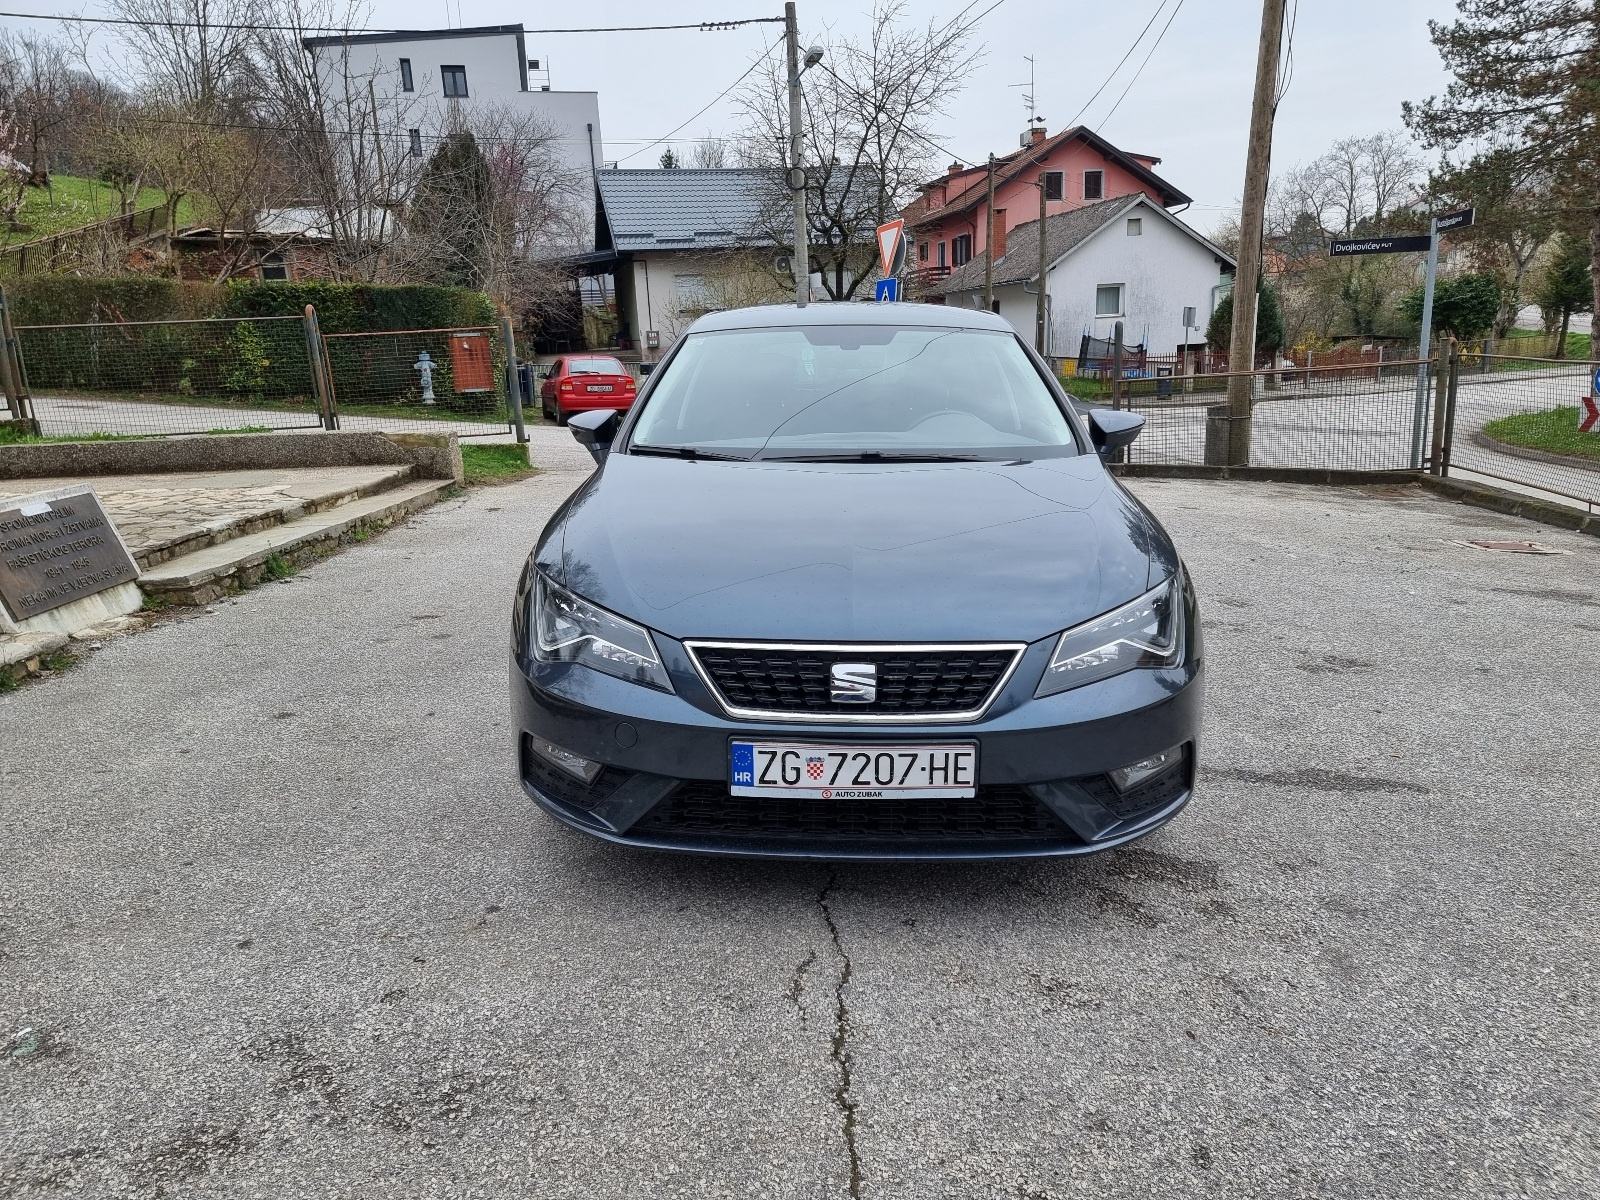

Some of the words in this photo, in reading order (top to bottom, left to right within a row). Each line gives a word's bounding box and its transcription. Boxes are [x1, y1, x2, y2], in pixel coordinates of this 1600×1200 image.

[1335, 242, 1380, 253] Dvojkovićev
[0, 512, 49, 533] SPOMENIK
[50, 505, 74, 520] PALIM
[67, 535, 104, 553] TERORA
[45, 563, 65, 579] 1941
[71, 556, 91, 571] 1945
[734, 772, 751, 783] HR
[757, 750, 801, 786] ZG
